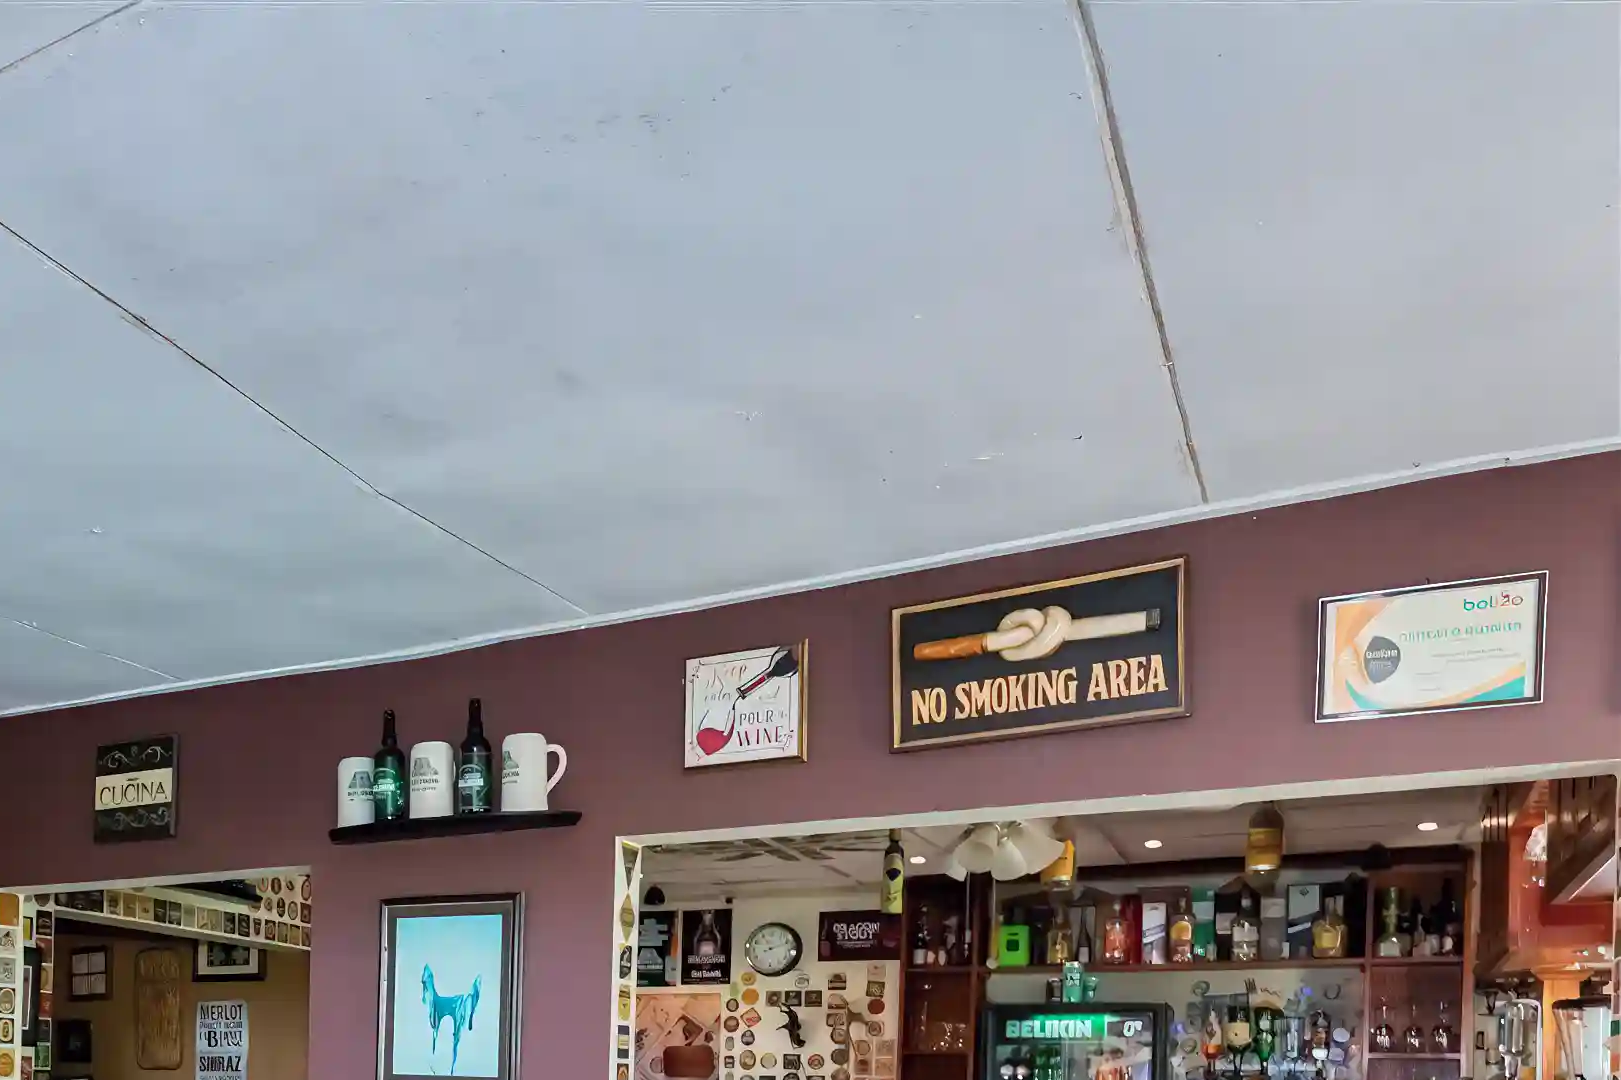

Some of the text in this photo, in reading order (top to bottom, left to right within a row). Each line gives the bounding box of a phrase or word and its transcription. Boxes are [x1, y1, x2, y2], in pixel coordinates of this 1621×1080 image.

[911, 654, 1169, 726] NO SMOKING AREA
[739, 708, 774, 726] POUR
[736, 725, 784, 747] WINE
[99, 781, 168, 805] CUCINA
[200, 1003, 243, 1020] MERLOT
[1005, 1019, 1092, 1038] BELIKIN
